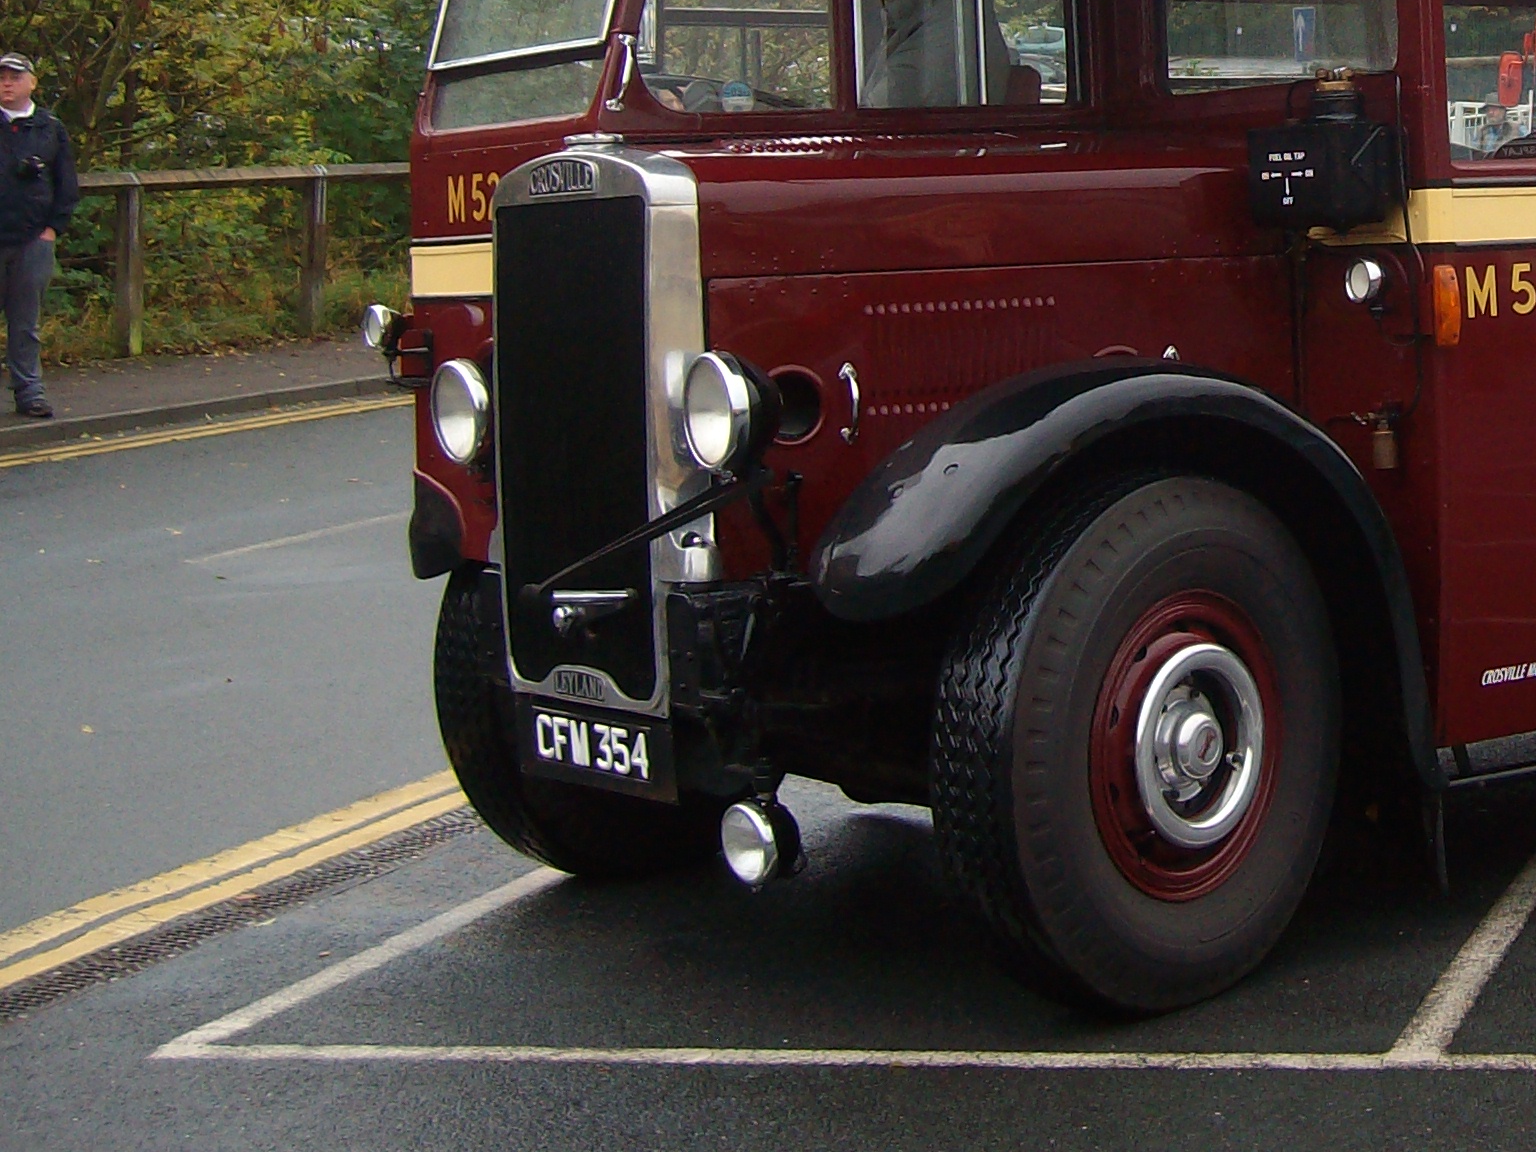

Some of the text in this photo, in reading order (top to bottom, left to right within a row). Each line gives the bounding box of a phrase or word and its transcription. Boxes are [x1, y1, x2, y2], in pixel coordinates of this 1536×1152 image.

[446, 174, 465, 224] M
[529, 161, 593, 195] CROSVILLE
[1465, 264, 1498, 319] M
[554, 671, 605, 700] LEYLAND
[1481, 664, 1527, 686] CROSVILLE
[593, 723, 649, 780] 354
